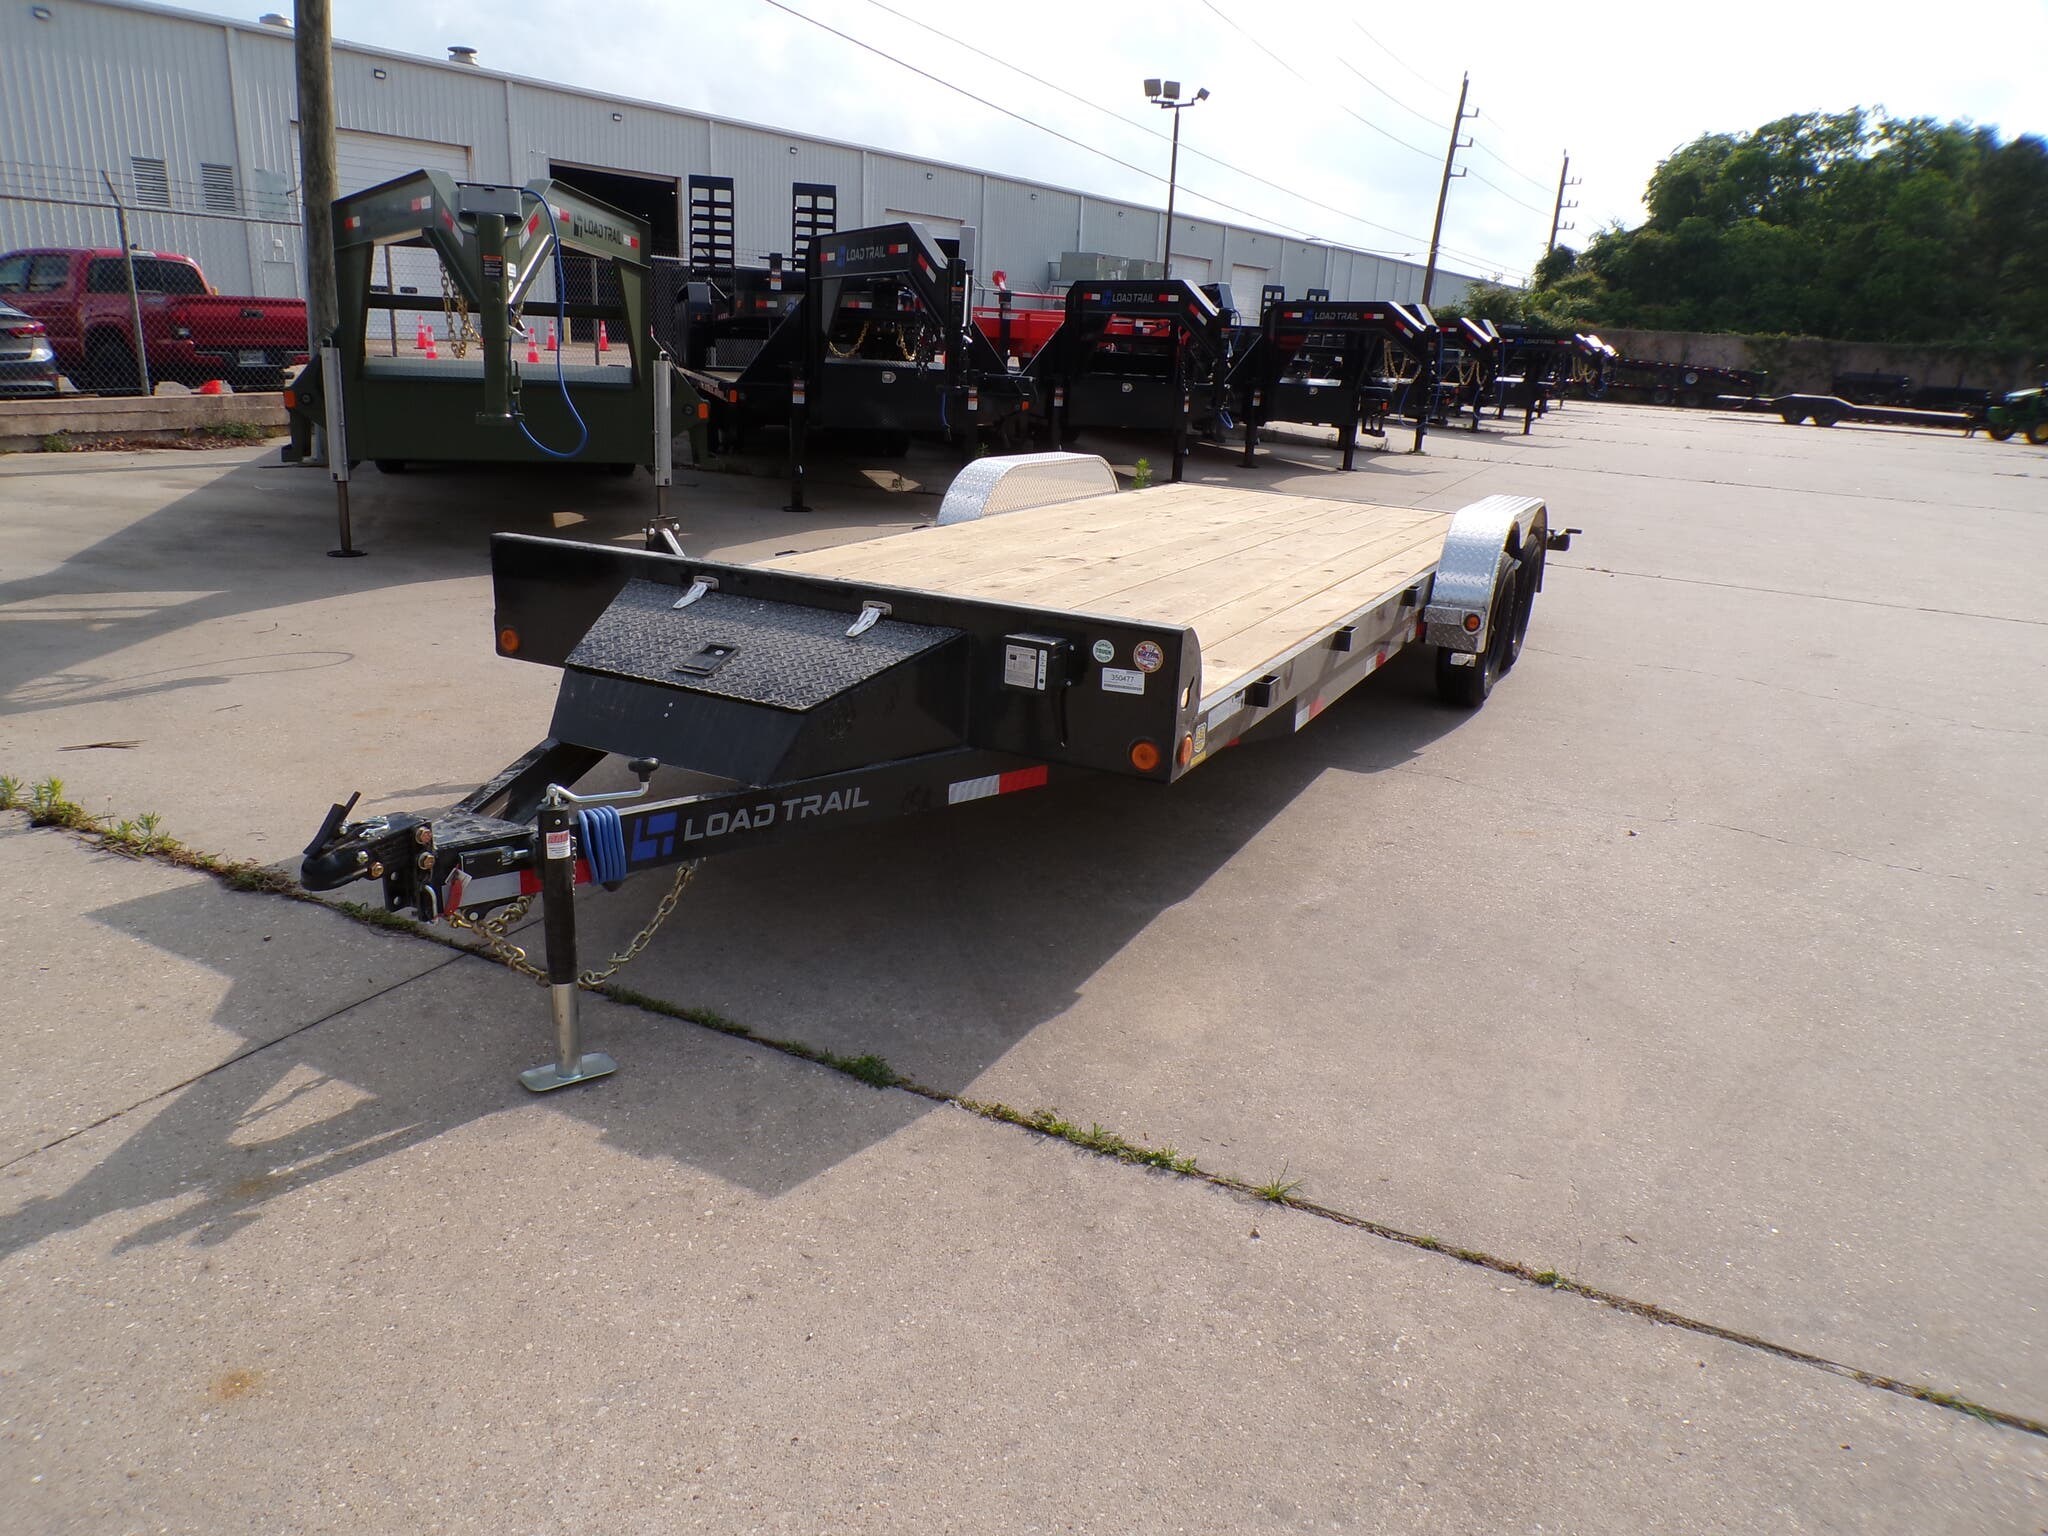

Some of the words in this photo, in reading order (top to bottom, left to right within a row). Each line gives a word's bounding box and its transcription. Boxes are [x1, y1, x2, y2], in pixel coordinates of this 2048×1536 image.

[846, 248, 864, 262] LOAD
[865, 245, 886, 259] TRAIL
[1111, 674, 1135, 683] 350477
[683, 804, 776, 842] LOAD
[781, 787, 870, 822] TRAIL
